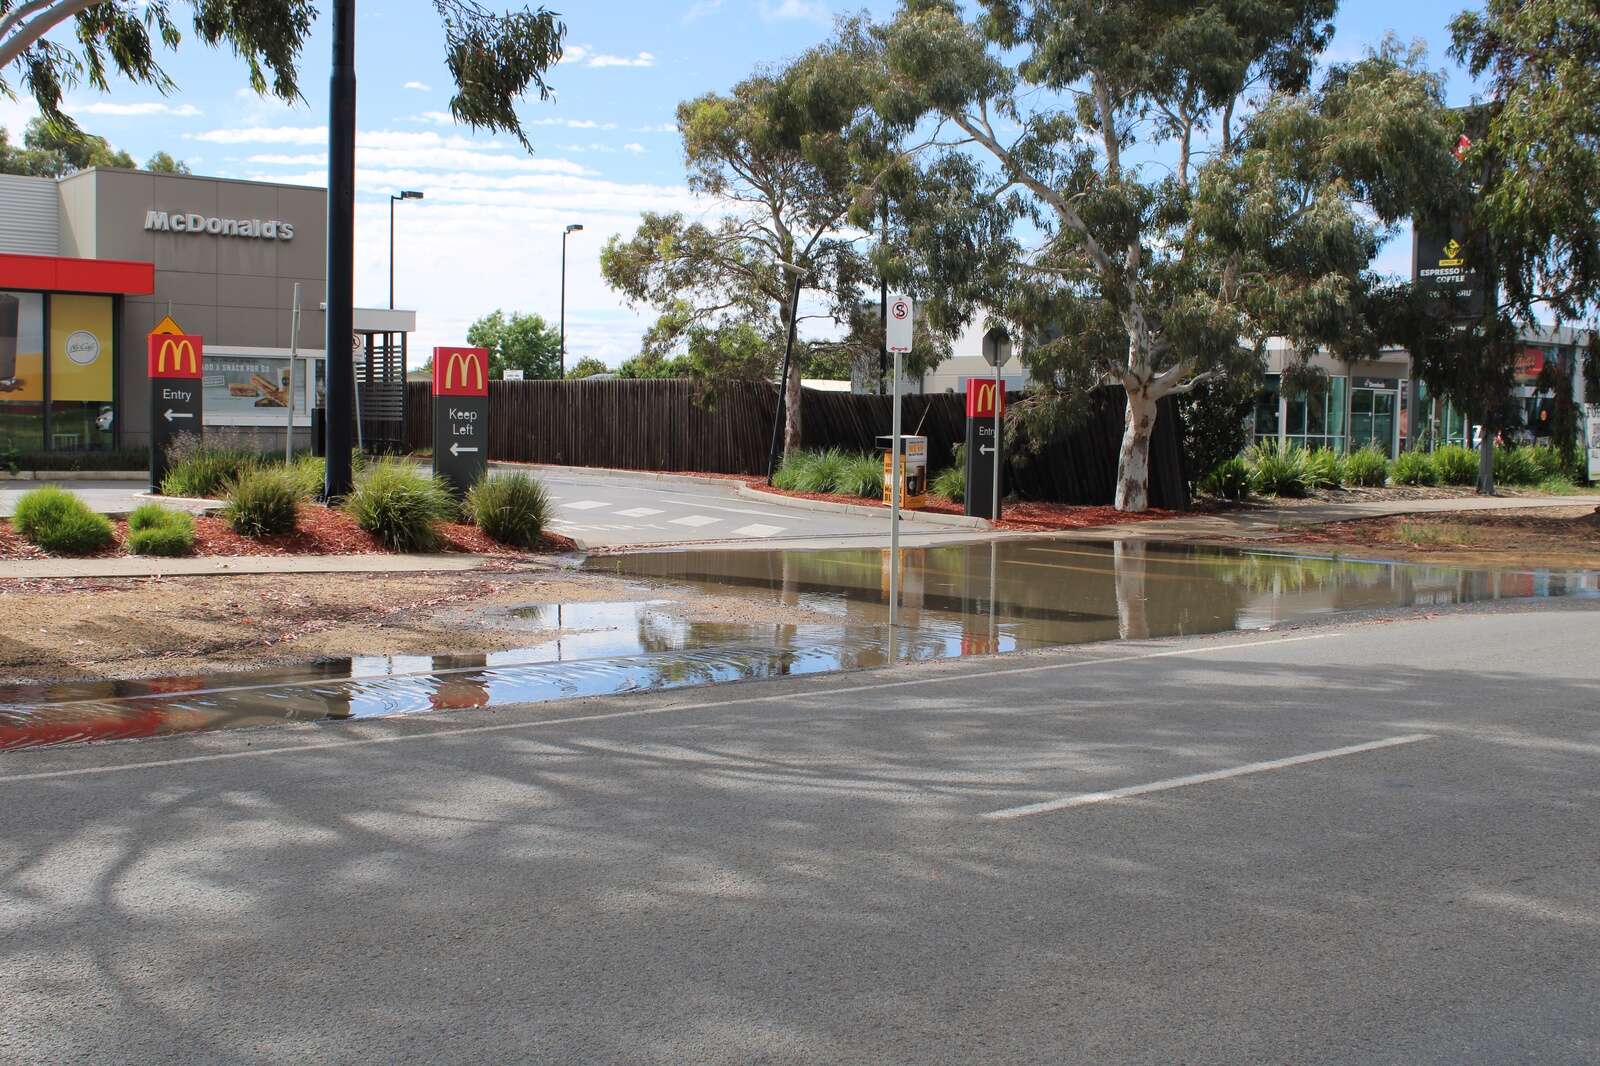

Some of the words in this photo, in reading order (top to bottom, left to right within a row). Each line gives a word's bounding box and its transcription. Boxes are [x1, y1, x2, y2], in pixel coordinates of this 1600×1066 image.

[144, 210, 295, 240] McDonald's
[1420, 268, 1460, 277] ESPRESSO
[163, 388, 192, 402] Entry
[449, 408, 477, 422] Keep
[452, 423, 474, 435] Left
[979, 426, 996, 438] Entr
